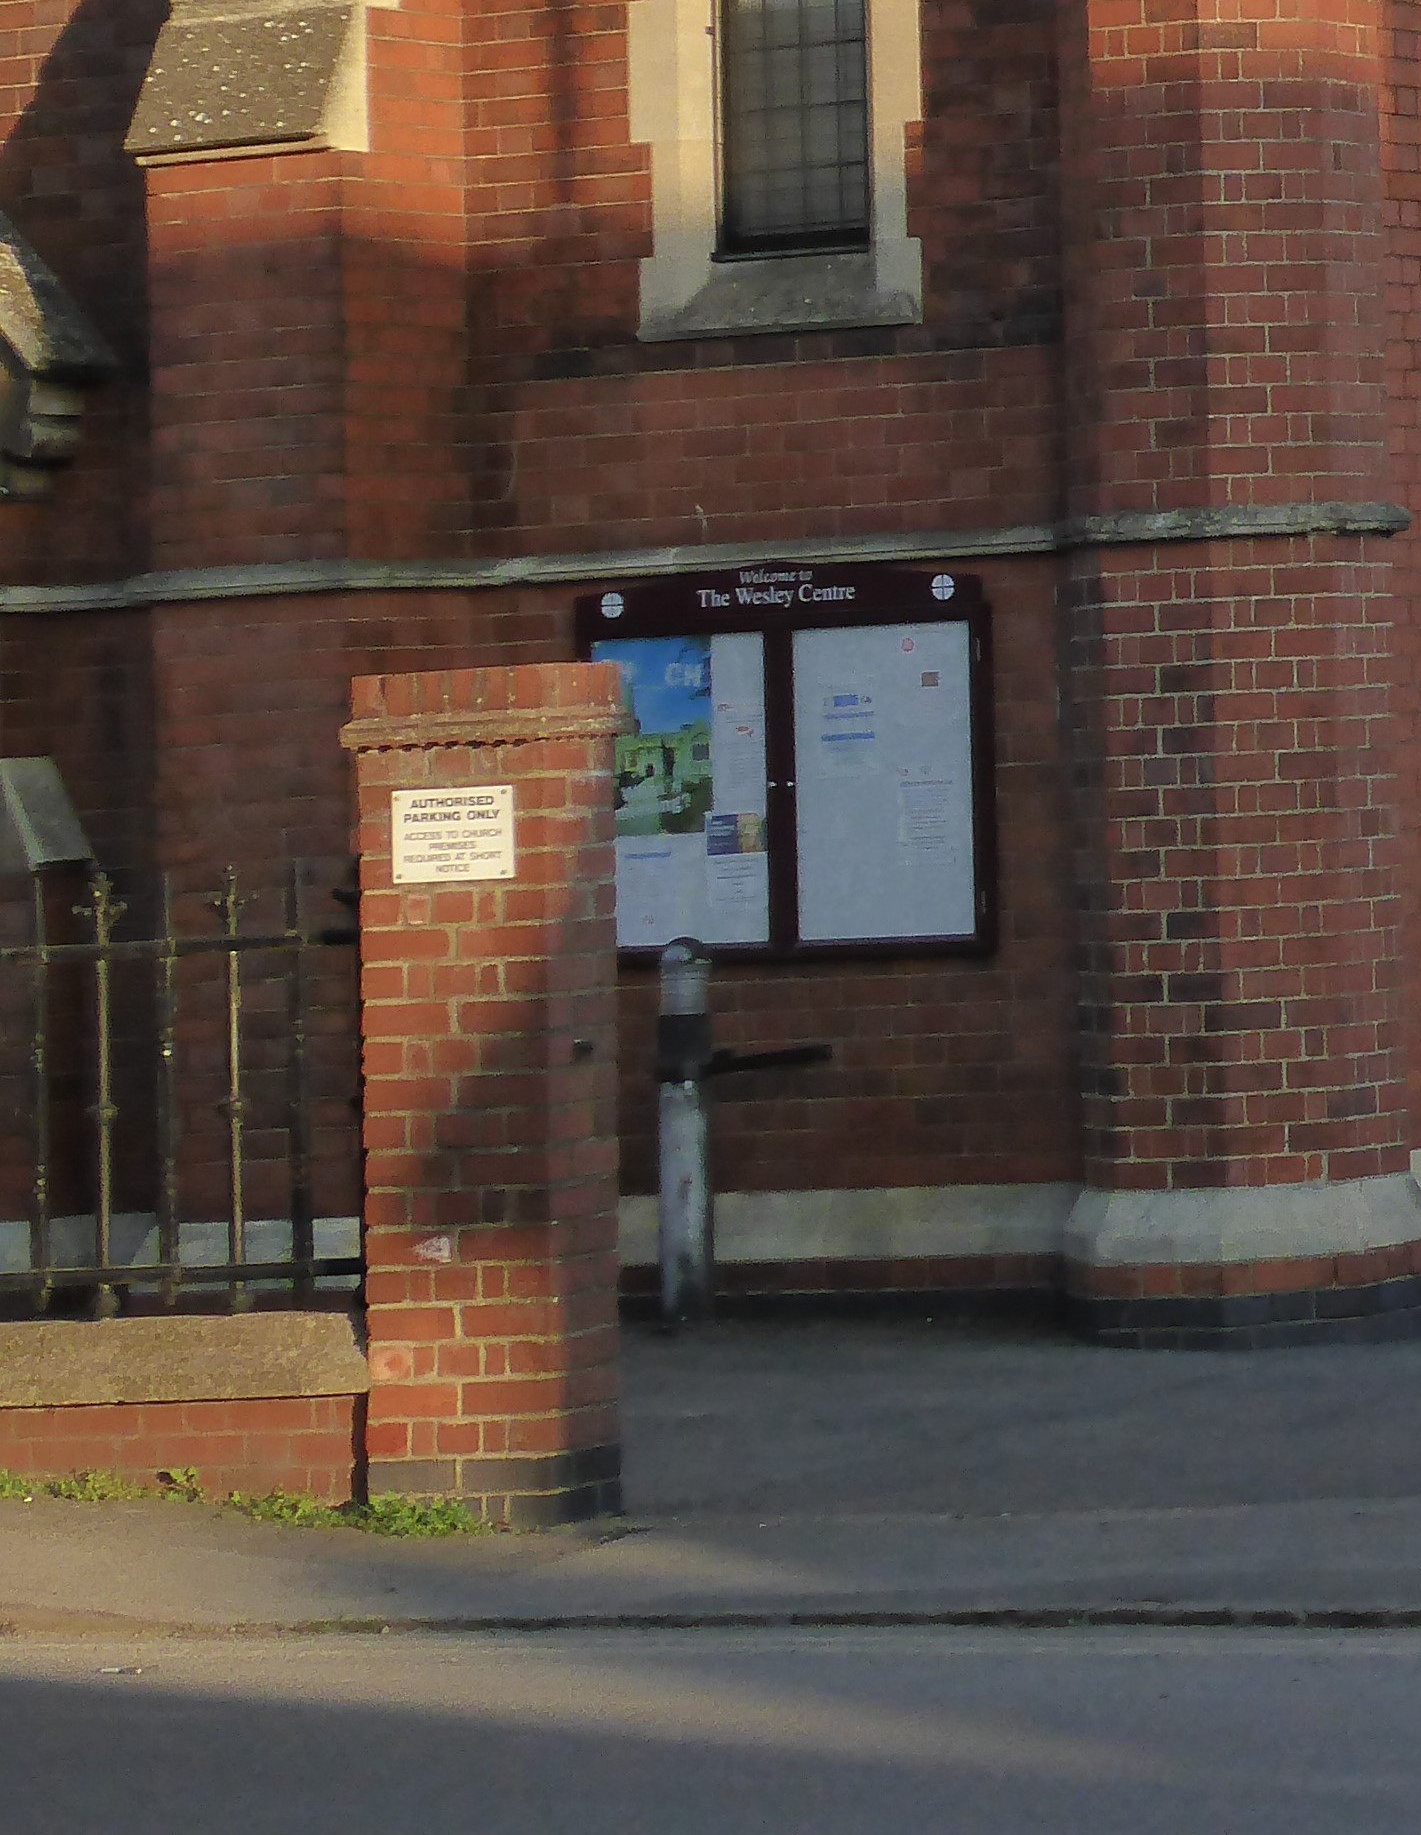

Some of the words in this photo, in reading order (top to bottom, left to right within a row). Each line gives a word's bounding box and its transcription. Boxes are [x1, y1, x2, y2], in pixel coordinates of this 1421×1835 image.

[739, 569, 795, 584] Welcome
[696, 589, 730, 607] The
[736, 586, 794, 608] Wesley
[798, 584, 855, 602] Centre
[410, 796, 494, 808] AUTHORISED
[403, 812, 461, 823] PARKING
[467, 810, 500, 820] ONLY
[404, 831, 442, 841] ACCESS
[446, 831, 458, 839] TO
[462, 829, 502, 838] CHURCH
[429, 841, 476, 850] PREMISES
[404, 854, 451, 862] REQUIRED
[454, 853, 466, 861] AT
[470, 851, 502, 860] SHORT
[435, 864, 470, 872] NOTICE
